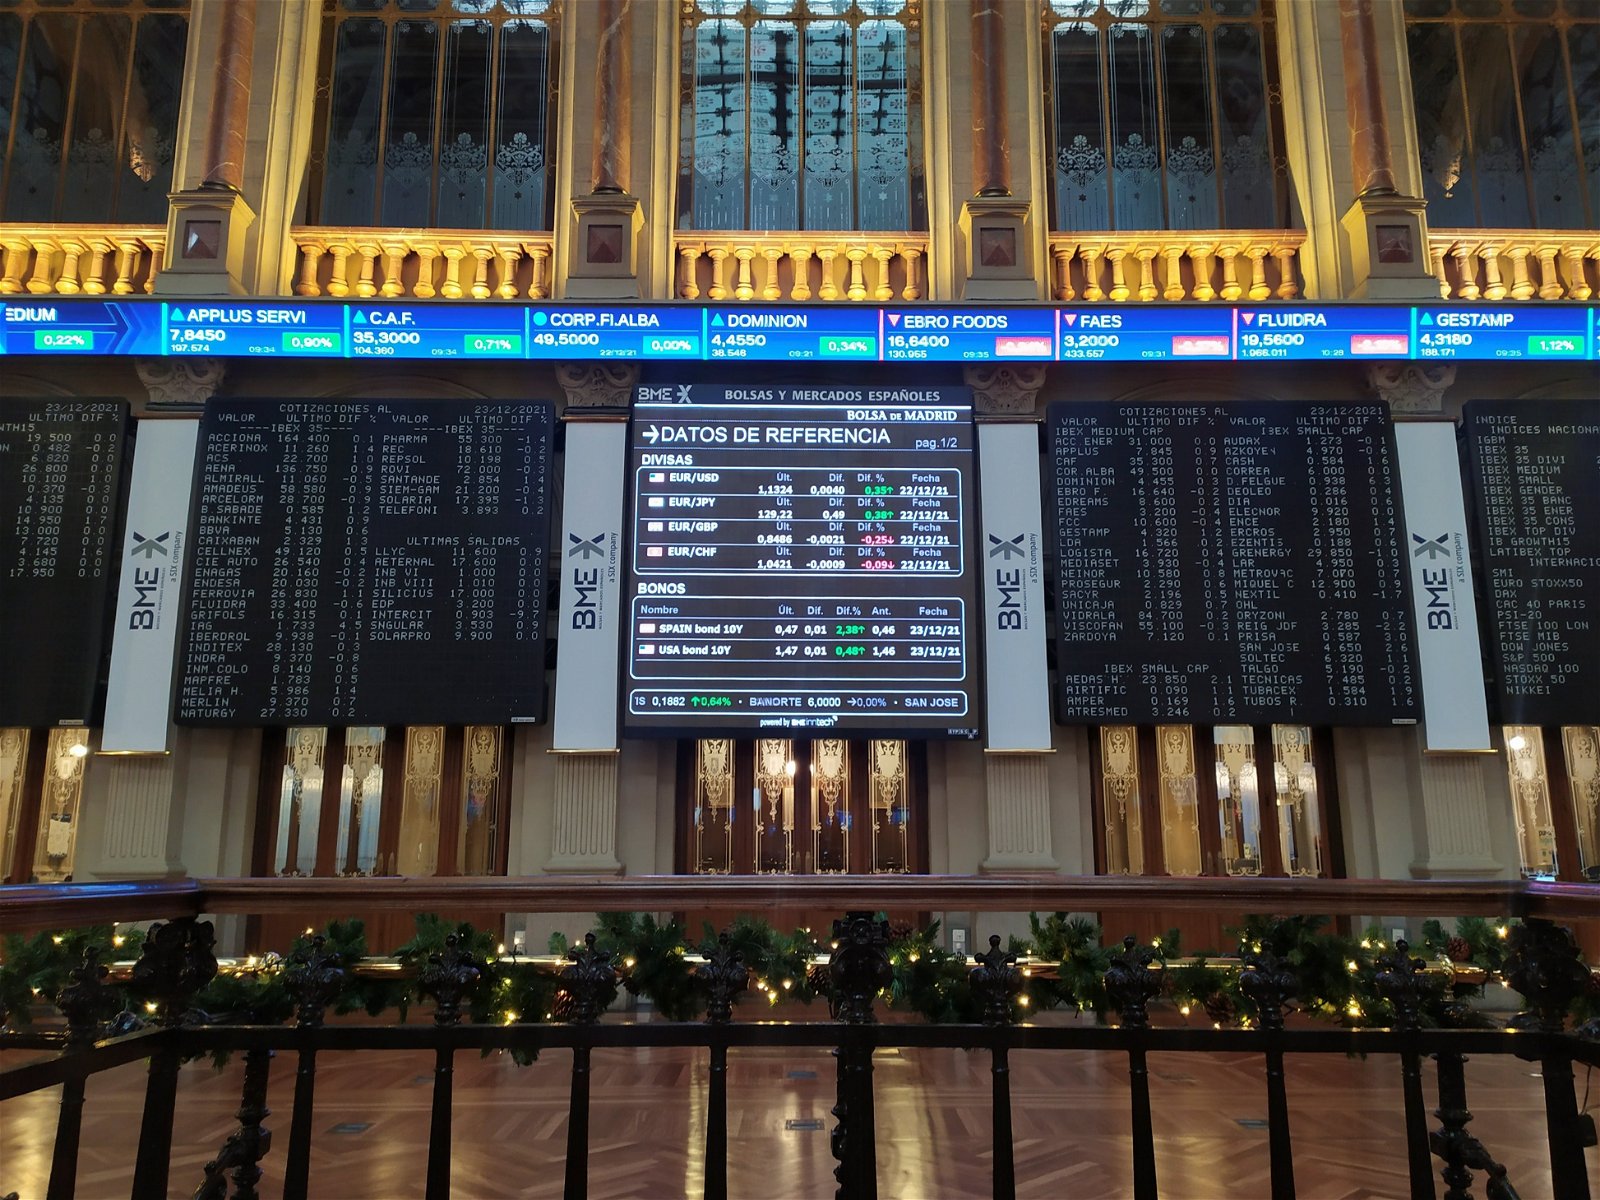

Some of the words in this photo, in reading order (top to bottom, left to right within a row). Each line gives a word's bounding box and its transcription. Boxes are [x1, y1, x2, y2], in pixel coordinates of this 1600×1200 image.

[187, 310, 252, 323] APPLUS
[257, 310, 306, 324] SERVI
[370, 312, 415, 324] C.A.F.
[550, 314, 659, 327] CORP.FI.ALBA
[728, 314, 807, 328] DOMINION
[904, 316, 949, 328] EBRO
[952, 316, 1008, 328] FOODS
[1080, 315, 1122, 328] FAES
[1258, 314, 1326, 326] FLUIDRA
[1437, 314, 1514, 326] GESTAMP
[44, 336, 84, 346] 0,22%
[170, 330, 226, 342] 7,8450
[354, 332, 420, 345] 35,3000
[534, 334, 599, 346] 49,5000
[712, 334, 766, 347] 4,4550
[1242, 334, 1304, 346] 19,5600
[1420, 334, 1472, 346] 4,3180
[292, 338, 332, 348] 0,90%
[474, 340, 511, 350] 0,71%
[828, 342, 867, 352] 0,34%
[888, 336, 949, 348] 16,6400
[1064, 336, 1119, 348] 3,2000
[1540, 341, 1574, 352] 1,12%
[171, 344, 210, 352] 197.574
[638, 388, 672, 400] BME
[725, 390, 773, 401] BOLSAS
[778, 390, 786, 401] Y
[792, 390, 862, 402] MERCADOS
[868, 388, 940, 402] ESPAÑOLES
[46, 404, 118, 412] 23/12/2021
[280, 404, 370, 412] COTIZACIONES
[378, 405, 392, 414] AL
[475, 406, 546, 414] 23/12/2021
[1120, 408, 1206, 416] COTIZACIONES
[1310, 407, 1382, 416] 23/12/2021
[30, 414, 74, 422] ULTIMO
[82, 414, 104, 422] DIF
[218, 414, 255, 422] VALOR
[286, 414, 332, 422] ULTIMO
[847, 410, 887, 420] BOLSA
[904, 411, 958, 421] MADRID
[661, 426, 728, 443] DATOS
[733, 427, 760, 443] DE
[766, 428, 890, 444] REFERENCIA
[1056, 427, 1084, 436] IBEX
[1092, 427, 1134, 436] MEDIUM
[1142, 428, 1164, 436] CAP
[1491, 426, 1540, 434] INDICES
[208, 434, 261, 442] ACCIONA
[384, 435, 428, 444] PHARMA
[208, 444, 268, 452] ACERINOX
[915, 438, 958, 450] pag.1/2
[1056, 447, 1099, 456] APPLUS
[382, 455, 426, 464] REPSOL
[642, 454, 692, 466] DIVISAS
[380, 476, 440, 484] SANTANDE
[670, 472, 719, 483] EUR/USD
[829, 474, 844, 482] Dif.
[912, 474, 940, 483] Fecha
[1057, 478, 1115, 486] DOMINION
[204, 485, 256, 494] AMADEUS
[758, 486, 792, 496] 1,1324
[810, 486, 845, 496] 0,0040
[900, 486, 948, 496] 22/12/21
[668, 498, 716, 508] EUR/JPY
[379, 506, 438, 514] TELEFONI
[758, 510, 792, 520] 129,22
[822, 510, 845, 520] 0,49
[1229, 508, 1280, 516] ELECNOR
[900, 510, 949, 521] 22/12/21
[200, 526, 230, 534] BBVA
[668, 522, 718, 533] EUR/GBP
[198, 536, 260, 545] CAIXABAN
[407, 536, 460, 546] ULTIMAS
[468, 536, 520, 546] SALIDAS
[757, 536, 792, 546] 0,8486
[806, 536, 845, 546] -0,0021
[900, 536, 950, 546] 22/12/21
[172, 531, 183, 564] company
[198, 547, 251, 556] CELLNEX
[609, 532, 618, 565] company
[668, 547, 717, 558] EUR/CHF
[1030, 533, 1038, 566] company
[1232, 548, 1292, 557] GRENERGY
[1454, 532, 1464, 566] company
[1490, 548, 1542, 556] LATIBEX
[1550, 548, 1571, 556] TOP
[757, 560, 792, 570] 1,0421
[806, 560, 845, 570] -0,0009
[900, 561, 950, 570] 22/12/21
[1061, 559, 1119, 568] MEDIASET
[194, 579, 240, 588] ENDESA
[638, 583, 686, 594] BONOS
[1062, 580, 1121, 588] PROSEGUR
[1494, 579, 1523, 588] EURO
[1531, 579, 1583, 588] STOXX50
[129, 568, 160, 630] BME
[572, 568, 598, 630] BME
[996, 568, 1022, 630] BME
[1422, 568, 1452, 630] BME
[1496, 600, 1518, 608] CAC
[1526, 600, 1540, 608] 40
[1548, 600, 1586, 608] PARIS
[640, 606, 678, 614] Nombre
[872, 606, 891, 616] Ant.
[920, 607, 948, 616] Fecha
[659, 624, 692, 634] SPAIN
[695, 624, 720, 634] bond
[724, 624, 743, 634] 10Y
[775, 625, 798, 636] 0,47
[804, 625, 827, 636] 0,01
[872, 625, 895, 636] 0,46
[910, 625, 960, 636] 23/12/21
[1064, 622, 1124, 630] VISCOFAN
[190, 632, 250, 641] IBERDROL
[370, 632, 431, 640] SOLARPRO
[189, 643, 242, 652] INDITEX
[659, 646, 680, 654] USA
[683, 645, 708, 654] bond
[712, 646, 731, 654] 10Y
[775, 646, 798, 656] 1,47
[804, 646, 827, 656] 0,01
[872, 646, 896, 656] 1,46
[910, 646, 960, 656] 23/12/21
[1501, 642, 1524, 652] DOW
[1532, 642, 1569, 652] JONES
[1504, 664, 1548, 673] NASDAQ
[1558, 664, 1580, 673] 100
[184, 676, 231, 685] MAPFRE
[1242, 676, 1302, 684] TECNICAS
[1506, 686, 1550, 695] NIKKEI
[652, 696, 686, 707] 0,1882
[750, 697, 802, 707] BANORTE
[808, 697, 841, 708] 6,0000
[904, 698, 927, 708] SAN
[930, 698, 958, 708] JOSE
[180, 708, 236, 718] NATURGY
[1068, 708, 1128, 716] ATRESMED
[760, 718, 782, 728] powered
[783, 718, 790, 728] by
